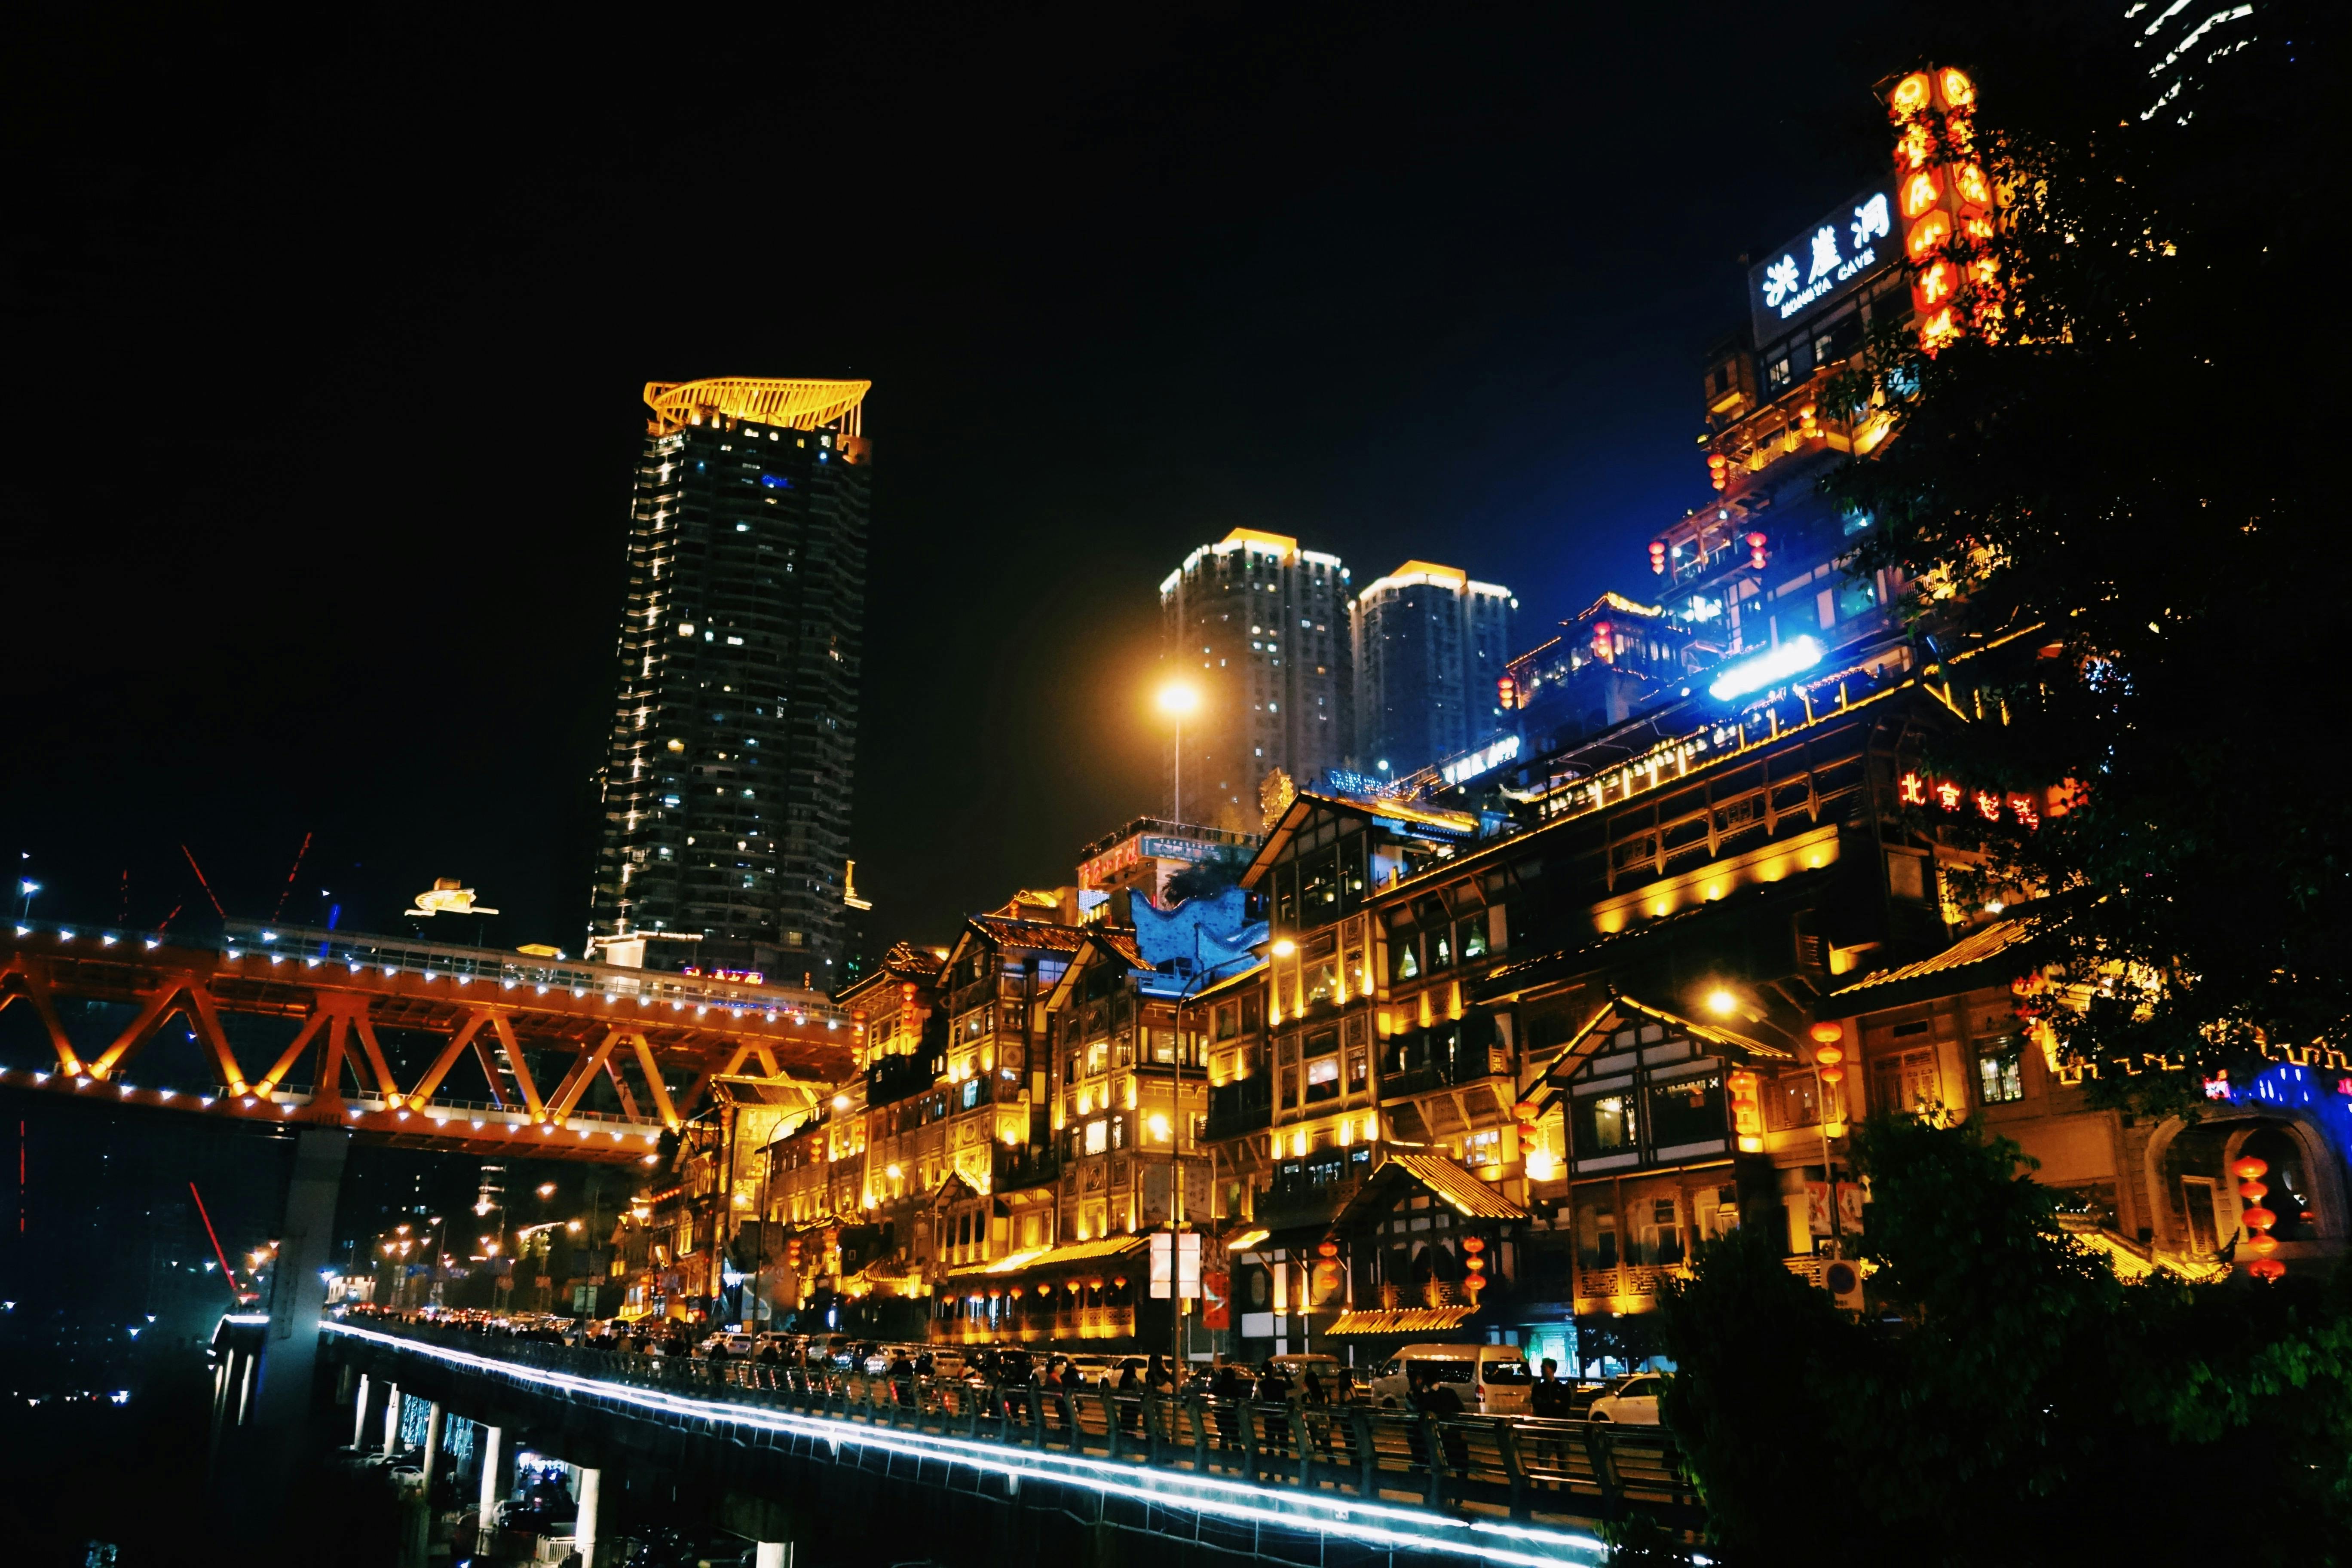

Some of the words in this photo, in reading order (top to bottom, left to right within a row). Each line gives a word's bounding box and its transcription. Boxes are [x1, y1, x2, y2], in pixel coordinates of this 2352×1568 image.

[1762, 193, 1890, 307] 洪崖洞
[1781, 277, 1833, 318] HONGYA
[1838, 247, 1876, 281] CAVE
